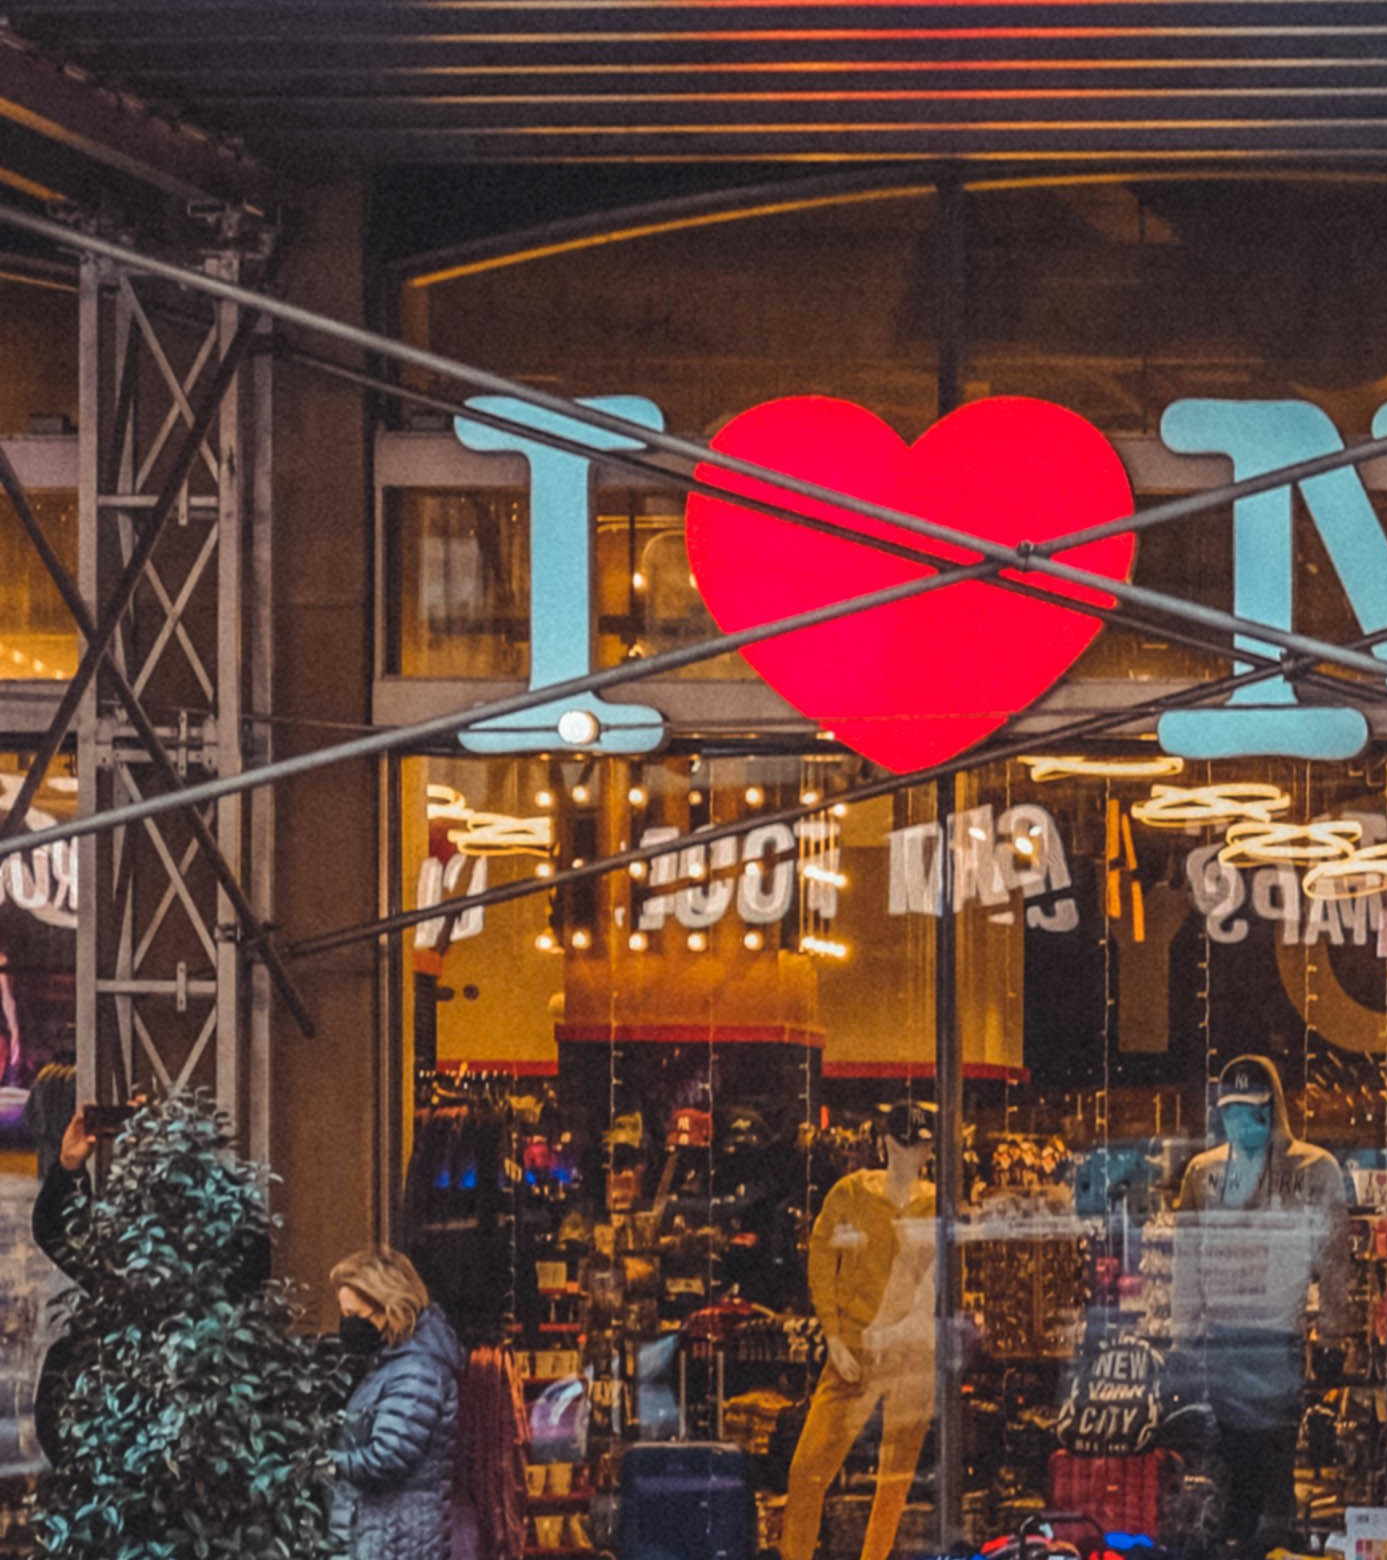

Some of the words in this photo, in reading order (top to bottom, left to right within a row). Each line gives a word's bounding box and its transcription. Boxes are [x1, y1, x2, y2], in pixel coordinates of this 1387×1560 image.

[454, 395, 665, 754] I
[1094, 1351, 1147, 1379] NEW
[1079, 1406, 1138, 1435] CITY
